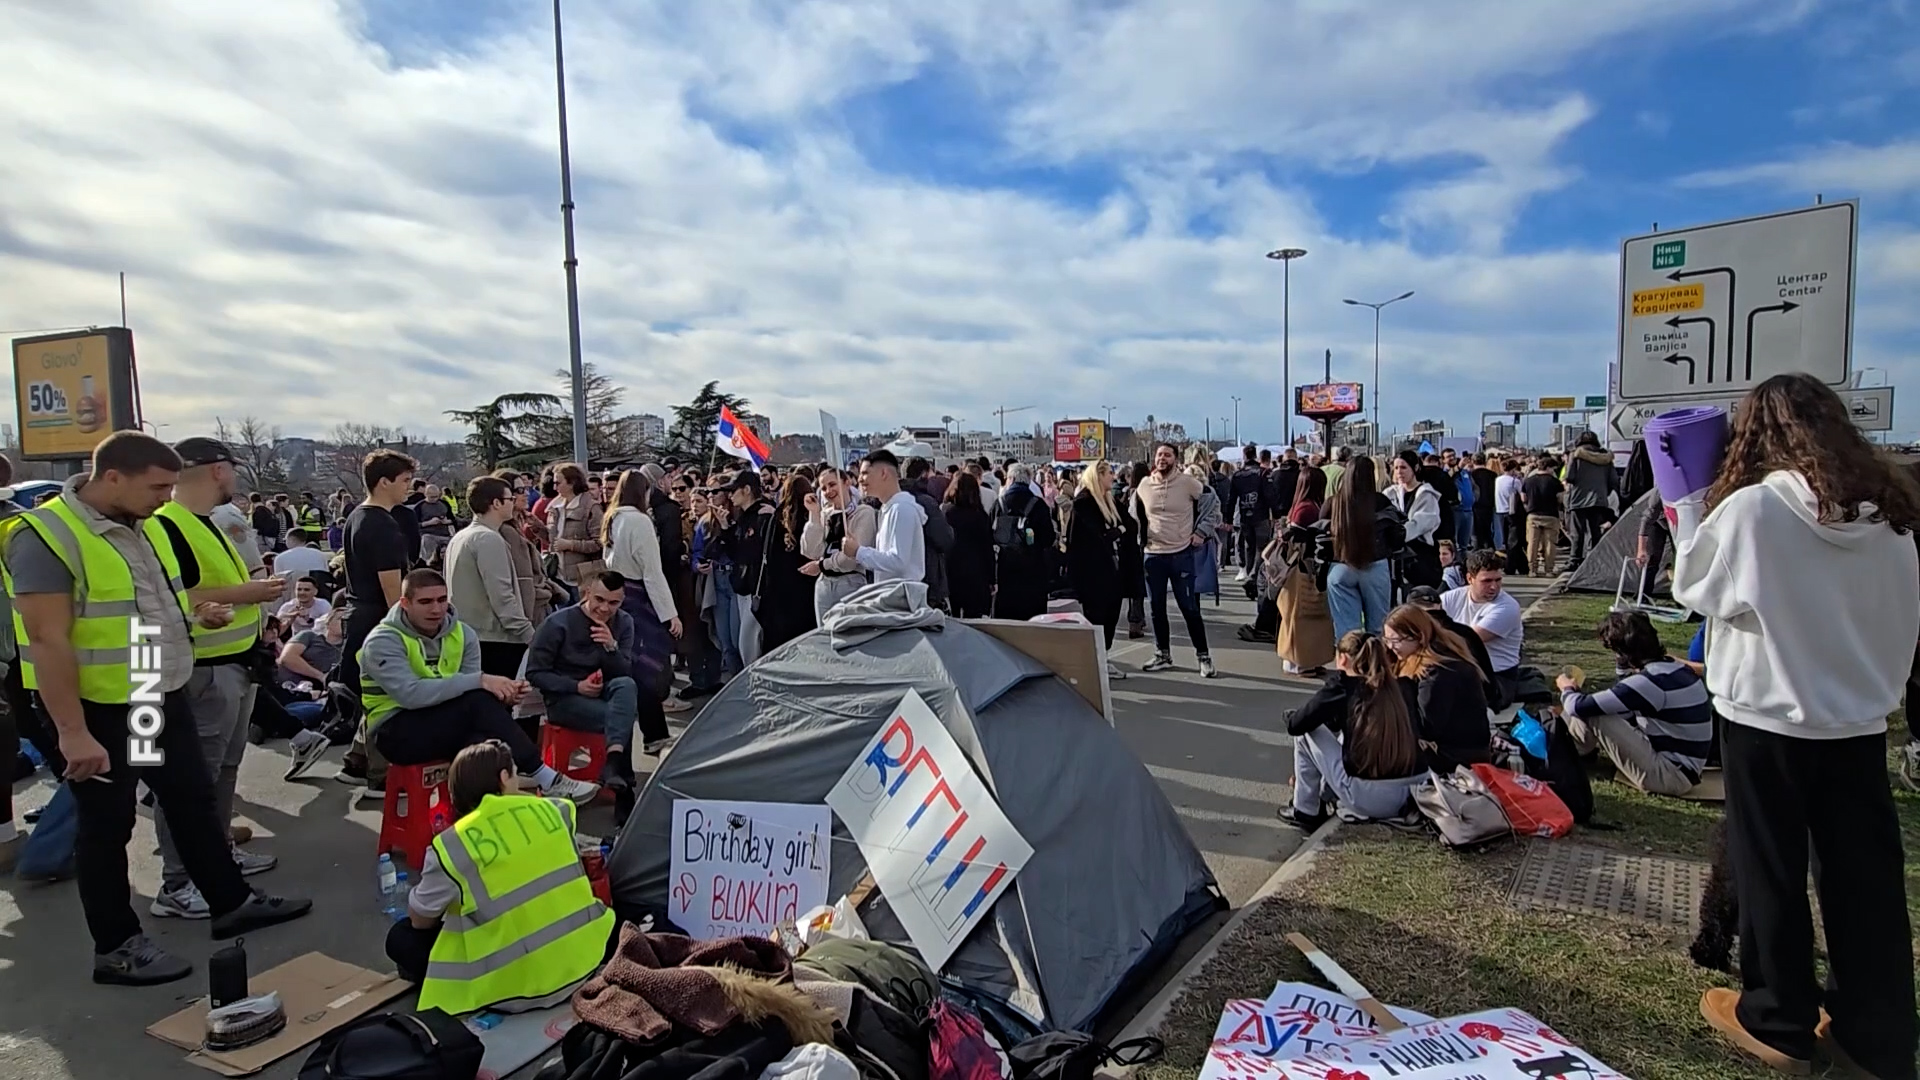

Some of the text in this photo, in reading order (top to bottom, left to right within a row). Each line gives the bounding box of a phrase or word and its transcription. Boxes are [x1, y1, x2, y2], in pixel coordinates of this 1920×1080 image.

[1656, 244, 1681, 256] Ниш
[1656, 257, 1674, 267] Niš
[1777, 272, 1828, 286] Центар
[1633, 287, 1699, 304] Крагујевац
[1779, 285, 1823, 298] Centar
[1633, 300, 1696, 315] Kragujevac
[1643, 330, 1689, 343] Бањица
[1645, 342, 1687, 354] Banjica
[29, 383, 67, 412] 50%
[465, 802, 562, 868] ВГГШ
[684, 808, 774, 869] Birthday
